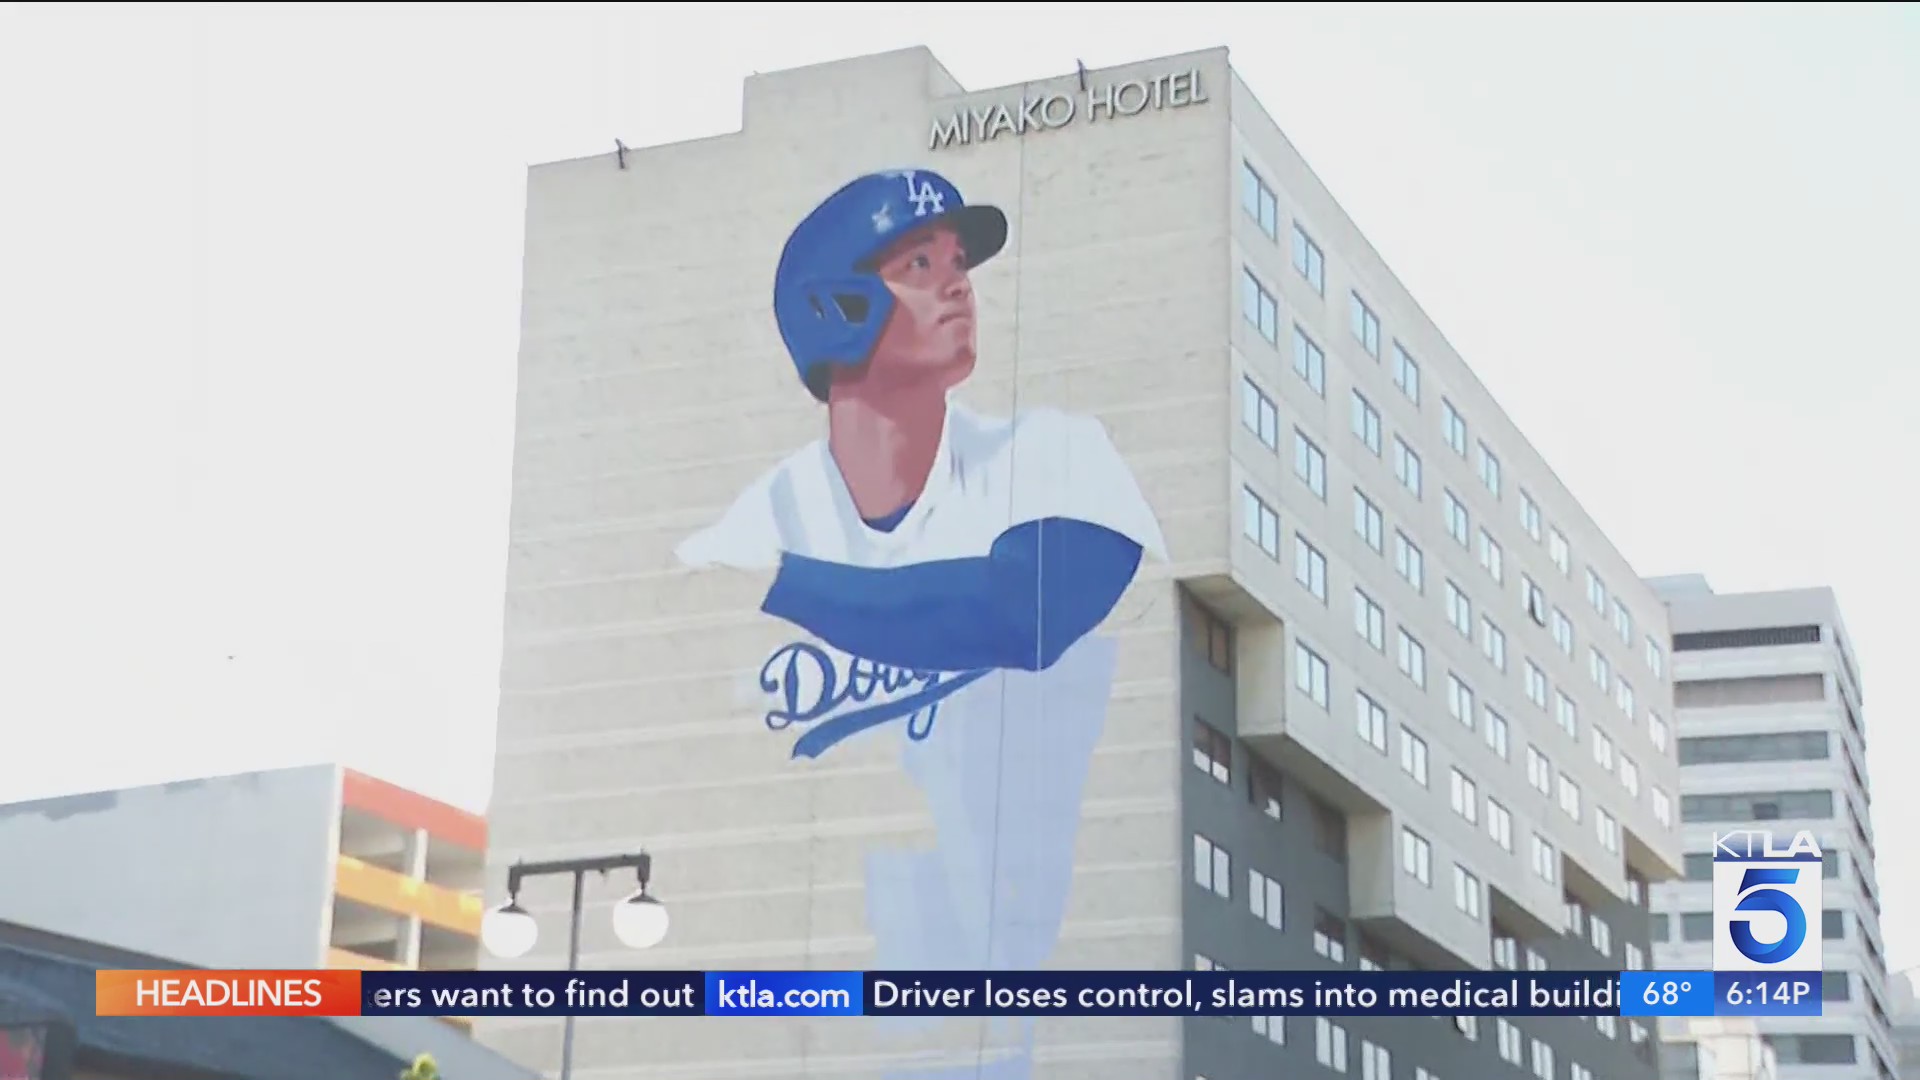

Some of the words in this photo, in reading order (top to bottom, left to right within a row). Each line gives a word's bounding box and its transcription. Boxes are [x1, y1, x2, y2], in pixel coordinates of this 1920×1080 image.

[929, 95, 1076, 150] MIYAKO
[1087, 68, 1208, 122] HOTEL
[904, 171, 944, 217] LA
